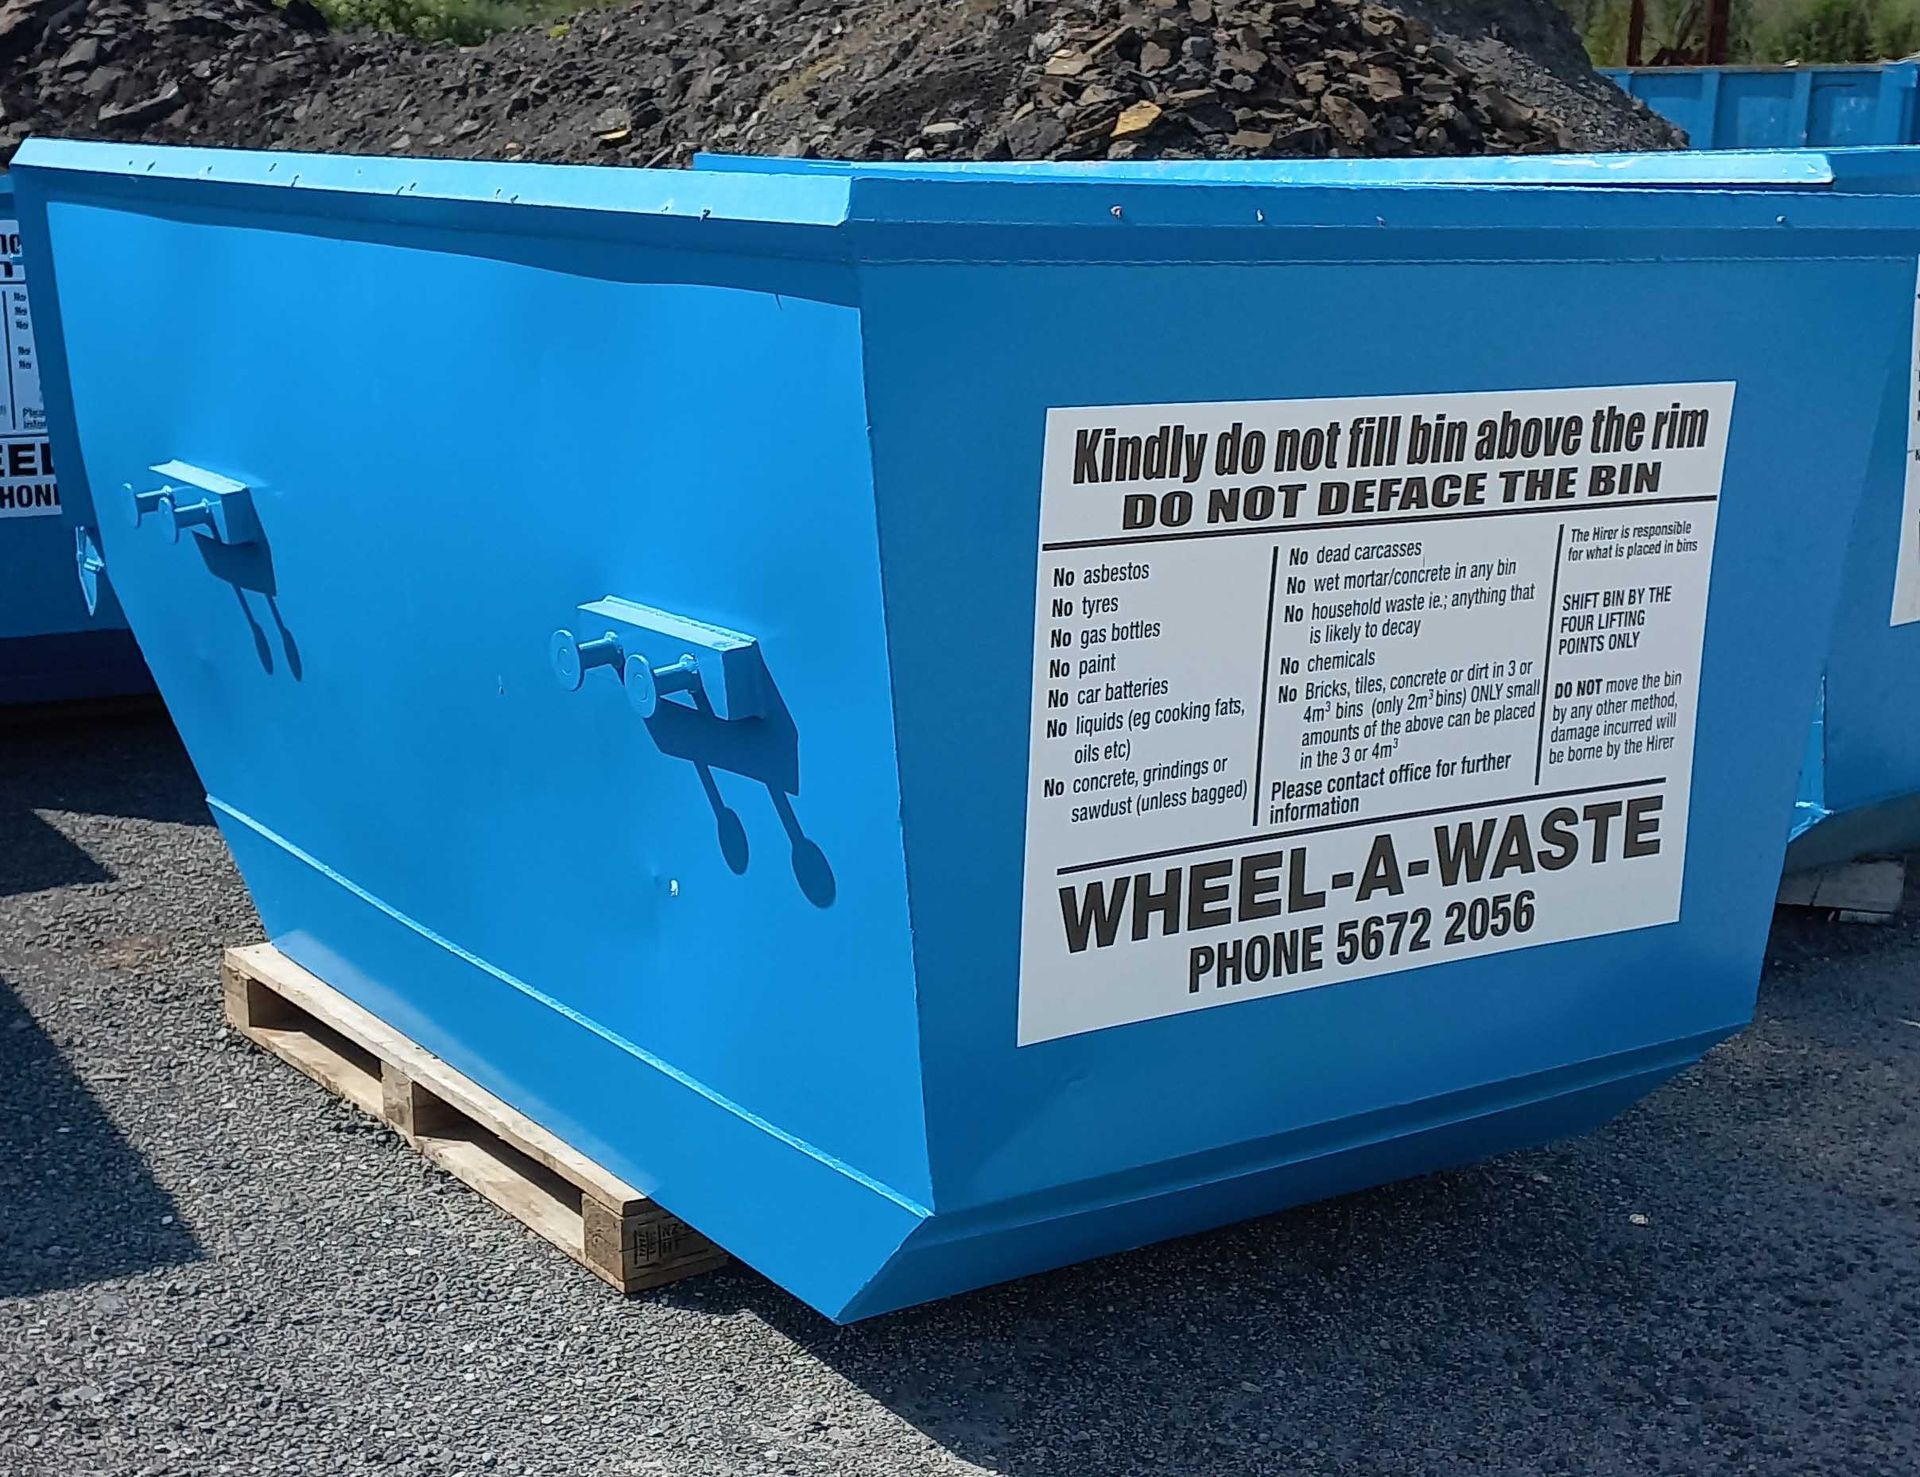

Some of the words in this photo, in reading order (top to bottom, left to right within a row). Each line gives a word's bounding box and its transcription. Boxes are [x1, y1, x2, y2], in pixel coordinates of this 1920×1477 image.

[1073, 428, 1205, 484] Kindly
[1215, 422, 1266, 475] do
[1274, 422, 1339, 471] not
[1348, 417, 1399, 467] fill
[1406, 413, 1468, 464] bin
[1475, 407, 1584, 461] above
[1591, 406, 1644, 453] the
[1651, 402, 1709, 449] rim
[1122, 490, 1191, 531] DO
[1208, 484, 1307, 524] NOT
[1318, 472, 1487, 516] DEFACE
[1498, 466, 1577, 503] THE
[1586, 462, 1663, 496] BIN
[1571, 528, 1590, 543] The
[1592, 526, 1619, 541] Hirer
[1621, 524, 1630, 539] is
[1632, 520, 1692, 540] responsible
[1289, 547, 1308, 566] No
[1316, 543, 1351, 565] dead
[1354, 540, 1422, 561] carcasses
[1568, 546, 1584, 561] for
[1586, 544, 1612, 560] what
[1615, 543, 1624, 557] is
[1626, 541, 1661, 559] placed
[1664, 540, 1674, 551] in
[1053, 567, 1075, 587] No
[1083, 562, 1150, 585] asbestos
[1286, 576, 1306, 595] No
[1314, 573, 1340, 591] wet
[1343, 563, 1451, 590] mortar/concrete
[1454, 561, 1467, 579] in
[1470, 561, 1494, 581] any
[1497, 557, 1517, 576] bin
[1052, 598, 1073, 617] No
[1082, 596, 1119, 619] tyres
[1284, 604, 1304, 623] No
[1311, 597, 1381, 621] household
[1385, 594, 1425, 614] waste
[1428, 592, 1448, 611] ie.;
[1451, 585, 1506, 609] anything
[1510, 583, 1536, 601] that
[1562, 592, 1600, 611] SHIFT
[1603, 589, 1625, 608] BIN
[1628, 587, 1646, 605] BY
[1649, 585, 1672, 603] THE
[1050, 629, 1072, 648] No
[1080, 627, 1107, 649] gas
[1111, 620, 1161, 642] bottles
[1309, 626, 1321, 644] is
[1325, 621, 1361, 644] likely
[1365, 621, 1378, 639] to
[1381, 617, 1421, 638] decay
[1560, 614, 1594, 634] FOUR
[1597, 609, 1646, 630] LIFTING
[1558, 635, 1605, 655] POINTS
[1608, 631, 1640, 650] ONLY
[1049, 659, 1070, 678] No
[1079, 653, 1116, 679] paint
[1280, 657, 1299, 676] No
[1307, 648, 1376, 673] chemicals
[1048, 689, 1069, 708] No
[1077, 687, 1100, 705] car
[1105, 678, 1169, 701] batteries
[1278, 685, 1298, 703] No
[1305, 680, 1350, 701] Bricks,
[1355, 676, 1386, 695] tiles,
[1389, 668, 1447, 691] concrete
[1450, 667, 1464, 683] or
[1467, 664, 1489, 682] dirt
[1492, 661, 1504, 679] in
[1508, 660, 1516, 677] 3
[1519, 659, 1534, 675] or
[1554, 681, 1572, 699] DO
[1576, 678, 1603, 697] NOT
[1606, 676, 1638, 693] move
[1642, 674, 1660, 689] the
[1664, 670, 1682, 687] bin
[1335, 700, 1364, 720] bins
[1371, 696, 1402, 719] (only
[1435, 687, 1467, 708] bins)
[1471, 684, 1503, 704] ONLY
[1506, 678, 1541, 698] small
[1552, 704, 1567, 724] by
[1570, 702, 1592, 721] any
[1596, 699, 1628, 715] other
[1630, 691, 1678, 711] method,
[1046, 719, 1068, 738] No
[1076, 712, 1124, 737] liquids
[1128, 709, 1150, 731] (eg
[1154, 702, 1210, 724] cooking
[1215, 698, 1245, 717] fats,
[1301, 725, 1360, 747] amounts
[1364, 720, 1377, 738] of
[1381, 719, 1401, 737] the
[1405, 713, 1444, 734] above
[1447, 710, 1470, 728] can
[1474, 707, 1490, 725] be
[1493, 702, 1536, 726] placed
[1551, 724, 1600, 743] damage
[1603, 715, 1653, 736] incurred
[1656, 712, 1677, 729] will
[1074, 744, 1100, 764] oils
[1104, 739, 1131, 761] etc)
[1300, 752, 1312, 770] in
[1316, 750, 1338, 768] the
[1341, 747, 1350, 764] 3
[1354, 746, 1368, 762] or
[1549, 748, 1564, 764] be
[1567, 745, 1603, 762] borne
[1606, 741, 1620, 760] by
[1624, 739, 1643, 755] the
[1646, 735, 1675, 752] Hirer
[1043, 778, 1065, 798] No
[1073, 769, 1138, 794] concrete,
[1143, 759, 1209, 787] grindings
[1213, 757, 1228, 773] or
[1271, 778, 1323, 802] Please
[1327, 767, 1385, 794] contact
[1389, 762, 1431, 784] office
[1436, 759, 1457, 777] for
[1461, 753, 1512, 775] further
[1071, 796, 1133, 823] sawdust
[1136, 791, 1187, 816] (unless
[1191, 779, 1248, 806] bagged)
[1269, 796, 1359, 825] information
[1058, 795, 1665, 954] WHEEL-A-WASTE
[1188, 923, 1324, 994] PHONE
[1336, 905, 1431, 965] 5672
[1444, 889, 1536, 945] 2056
